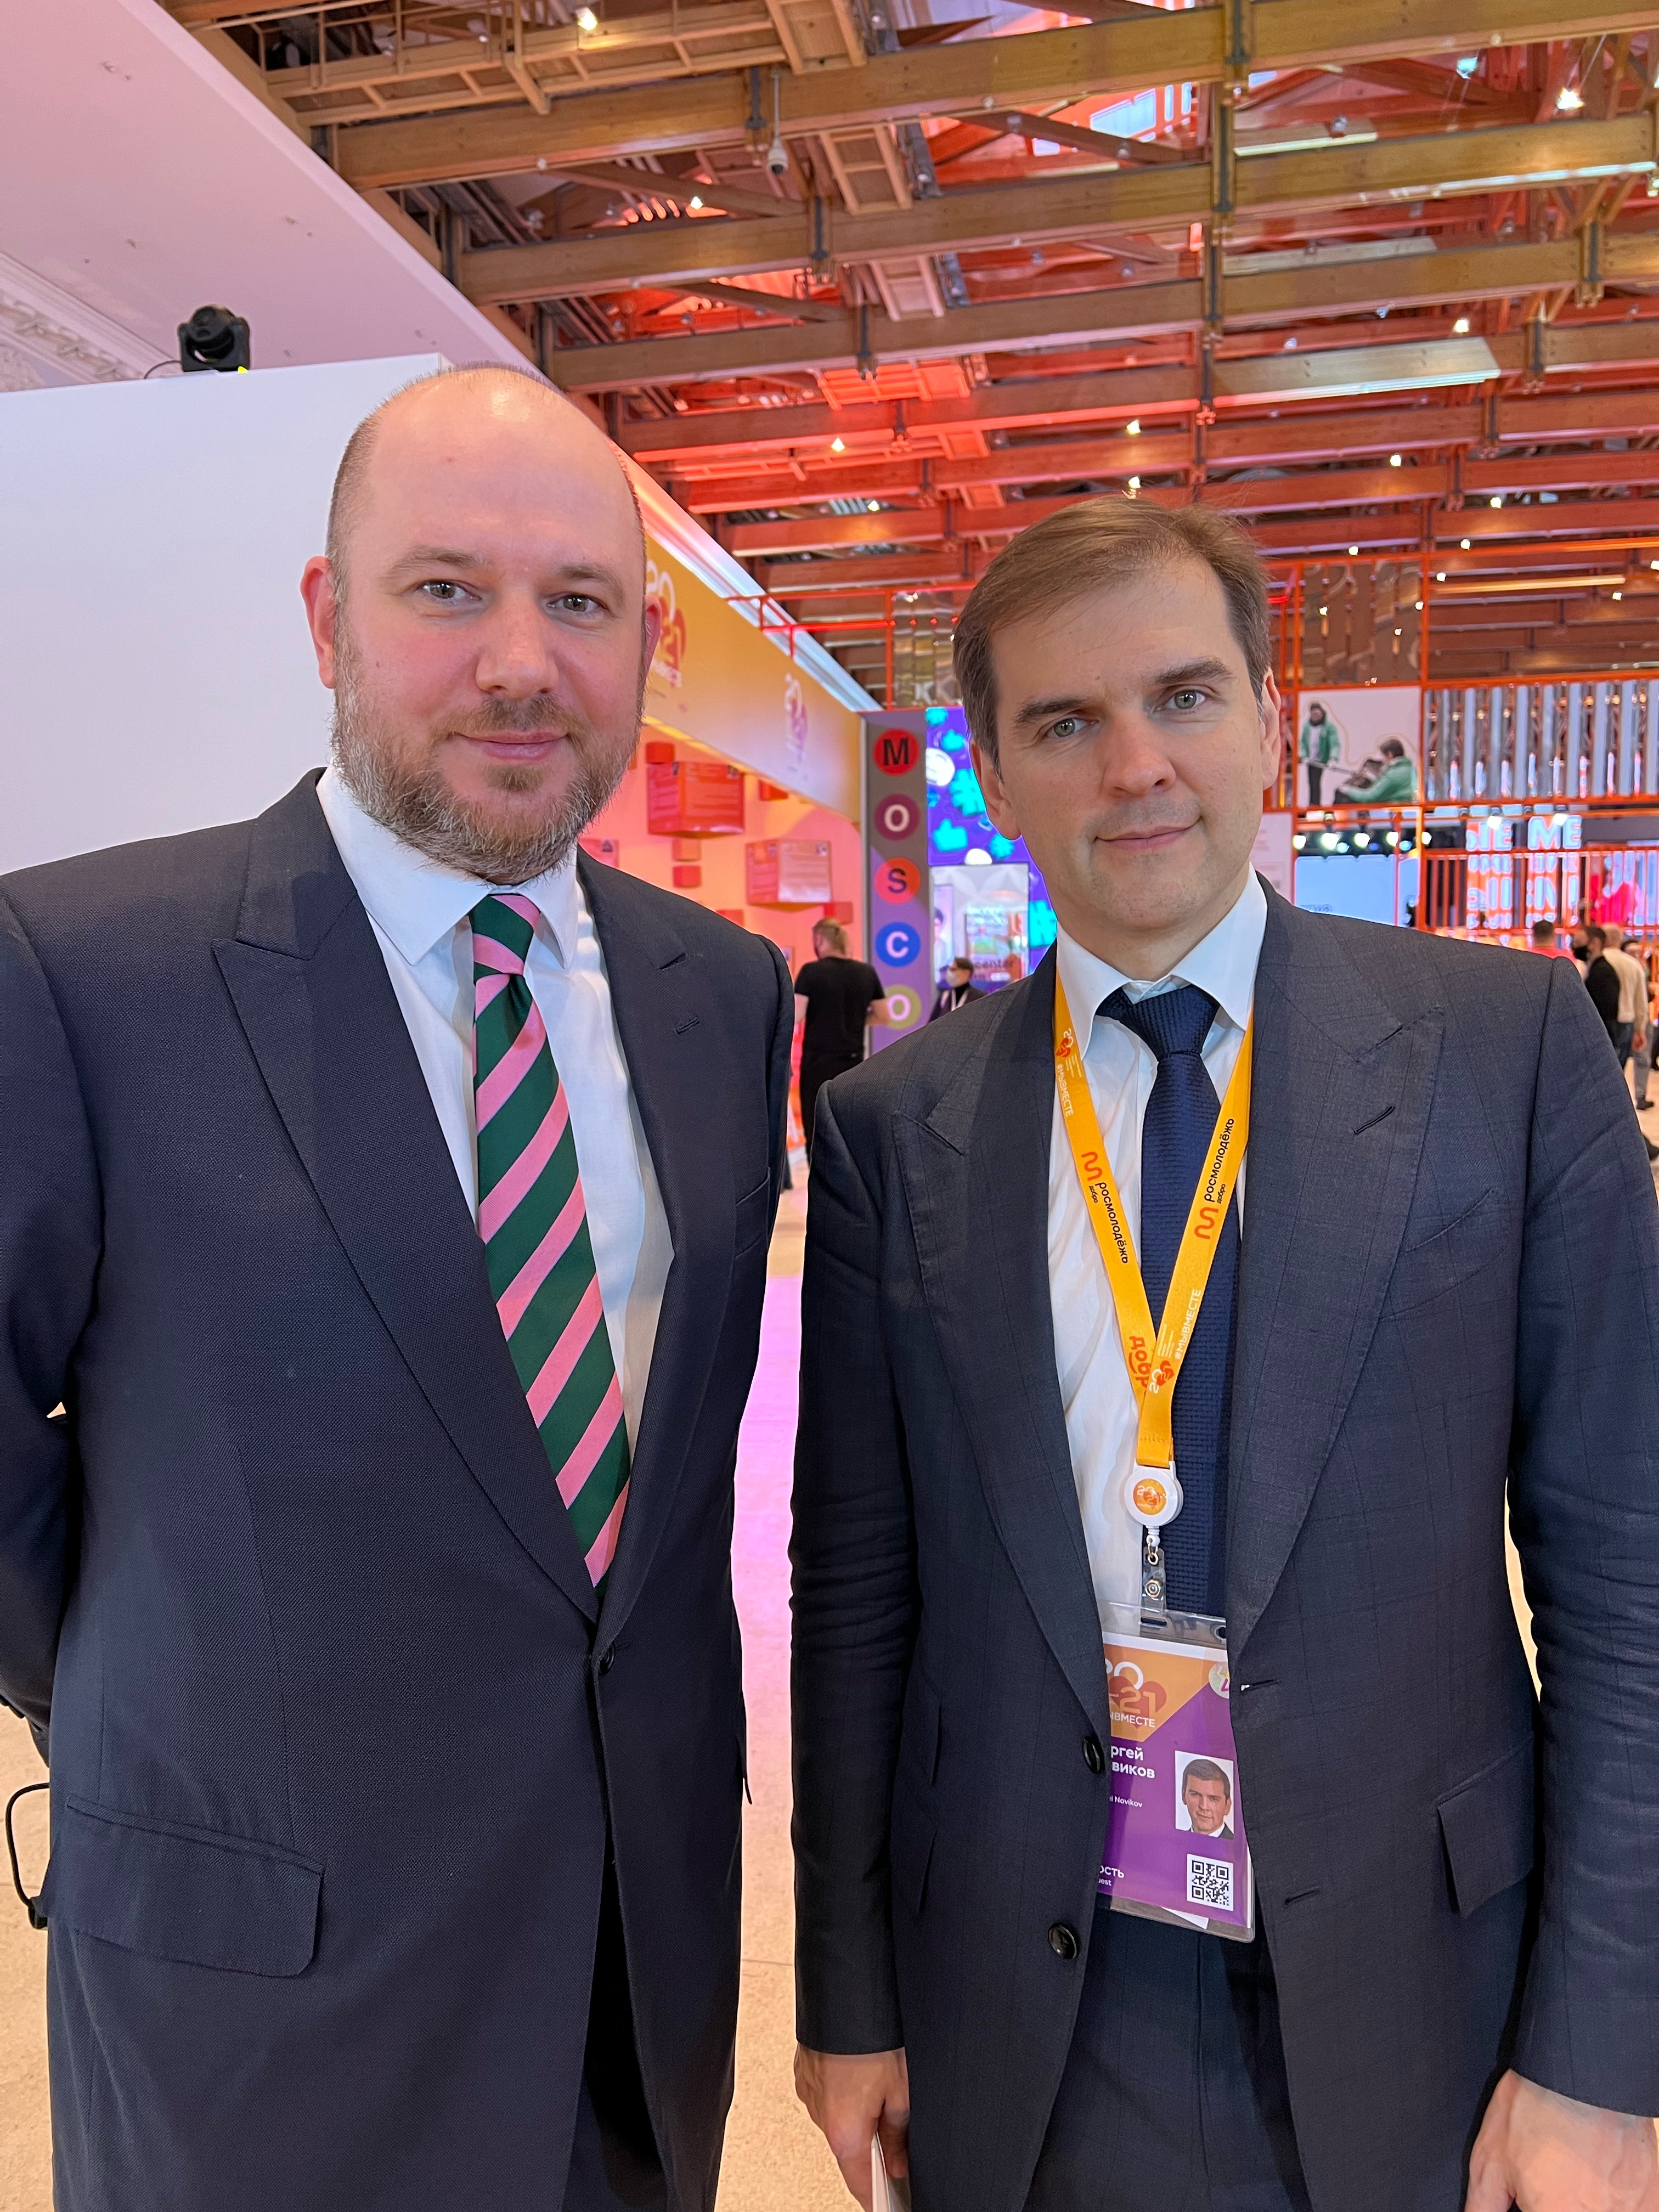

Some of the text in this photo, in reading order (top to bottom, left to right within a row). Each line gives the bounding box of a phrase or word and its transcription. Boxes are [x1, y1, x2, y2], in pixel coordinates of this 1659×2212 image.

[1057, 1063, 1074, 1118] #МЫВМЕСТЕ
[1204, 1118, 1234, 1202] росмолодёжь
[1095, 1182, 1128, 1263] росмолодёжь
[1174, 1289, 1201, 1359] #МЫВМЕСТЕ
[1129, 1336, 1151, 1396] добр
[1110, 1745, 1143, 1760] ргей
[1111, 1762, 1155, 1779] виков
